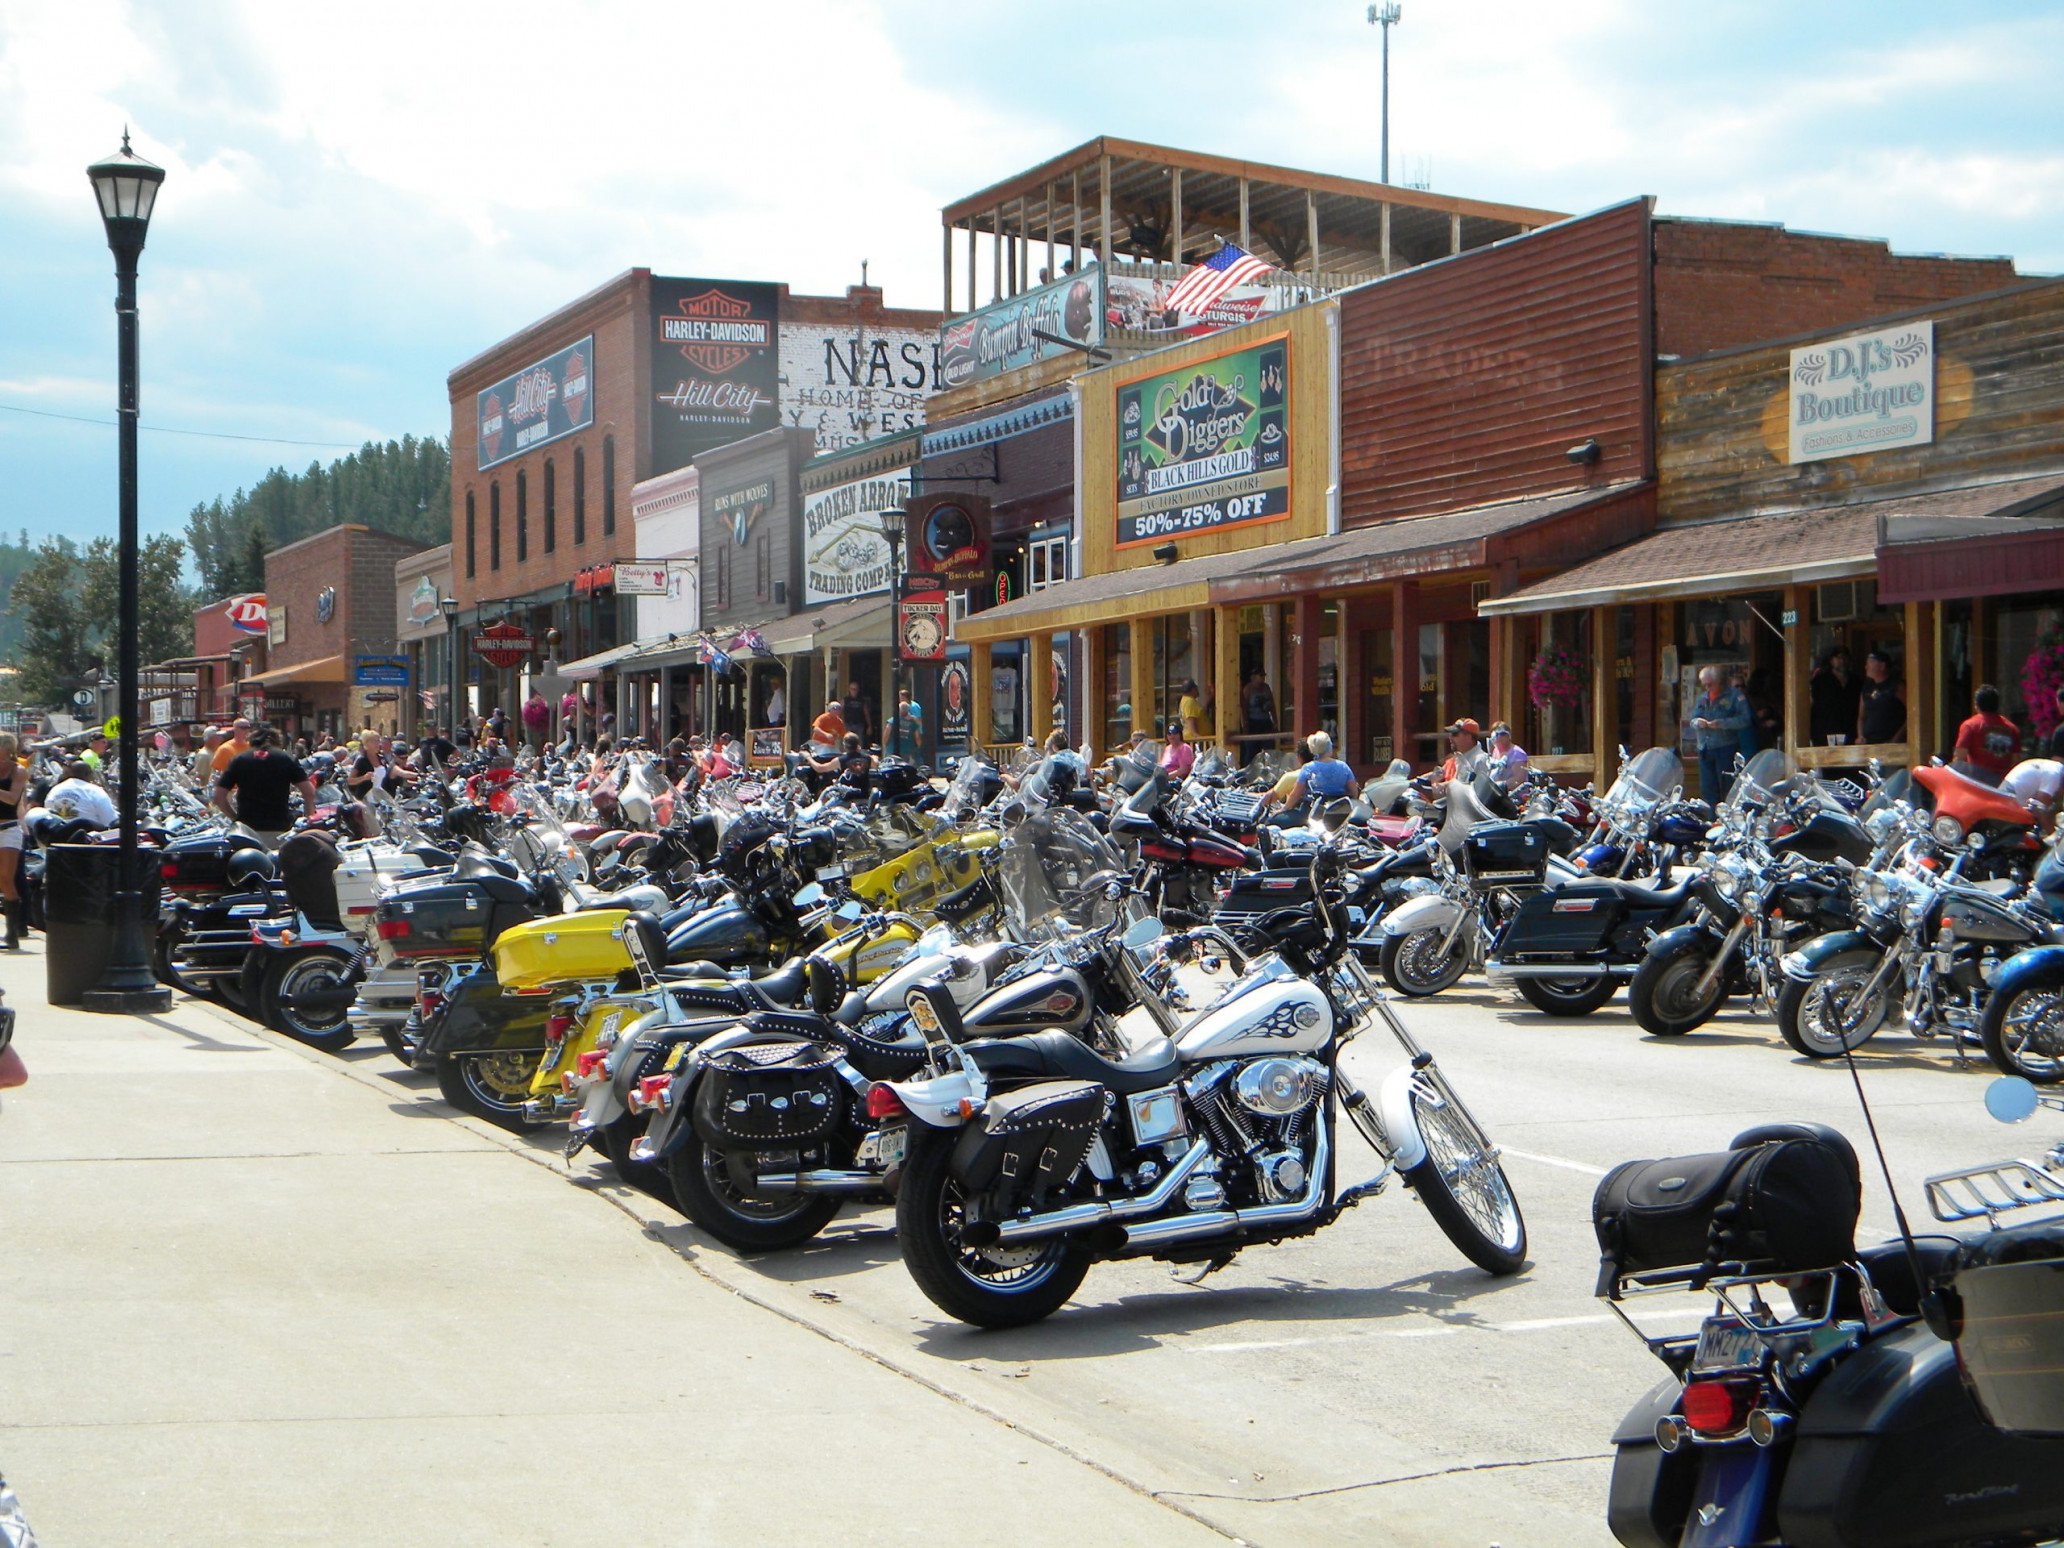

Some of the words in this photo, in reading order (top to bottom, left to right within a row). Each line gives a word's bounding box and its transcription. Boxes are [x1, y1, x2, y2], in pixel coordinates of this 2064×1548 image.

[688, 295, 741, 317] MOTOR
[1208, 300, 1259, 313] udweiser
[665, 319, 766, 343] HARLEY-DAVIDSON
[978, 307, 1018, 371] Bumpin
[1018, 294, 1060, 360] Buffalo
[689, 345, 740, 370] CYCLES
[947, 366, 960, 379] BUD
[958, 360, 976, 376] LIGHT
[659, 380, 713, 407] Hill
[712, 382, 771, 414] City
[799, 387, 873, 411] HOME
[1155, 373, 1215, 433] Gold
[1796, 381, 1925, 426] Boutique
[680, 414, 751, 424] HARLEY-DAVIDSON
[848, 411, 927, 434] WES
[1162, 411, 1245, 466] Diggers
[1804, 433, 1843, 449] Fashions
[1846, 430, 1853, 442] &
[1856, 420, 1913, 440] Accessories
[1151, 467, 1185, 490] BLACK
[1187, 457, 1217, 482] HILLS
[1218, 451, 1249, 475] GOLD
[730, 489, 745, 507] WITH
[744, 483, 768, 502] WOLVES
[1140, 492, 1183, 512] FACTORY
[1186, 483, 1225, 502] OWNED
[1227, 475, 1262, 492] STORE
[806, 485, 856, 538] BROKEN
[859, 480, 909, 513] ARROW
[1135, 502, 1222, 536] 50%-75%
[1227, 493, 1267, 518] OFF
[618, 567, 652, 579] Betty's
[809, 571, 853, 594] TRADING
[855, 551, 906, 592] COMPAY
[1782, 610, 1797, 624] 223
[476, 639, 532, 649] HARLEY-DAVIDSON
[1685, 618, 1750, 647] AVON
